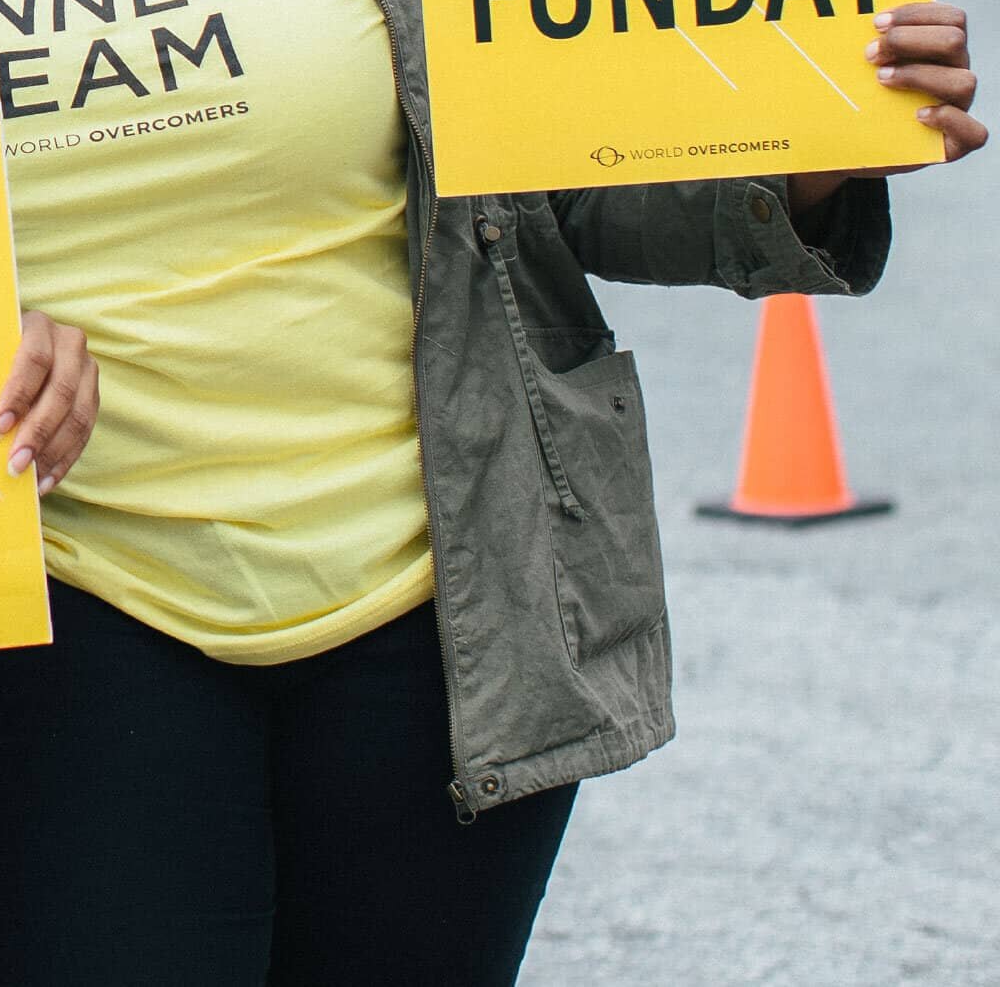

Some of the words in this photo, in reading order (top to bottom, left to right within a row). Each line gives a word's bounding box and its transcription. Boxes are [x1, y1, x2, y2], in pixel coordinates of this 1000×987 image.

[88, 100, 250, 143] OVERCOMERS
[629, 146, 683, 160] WORLD
[688, 139, 790, 156] OVERCOMERS
